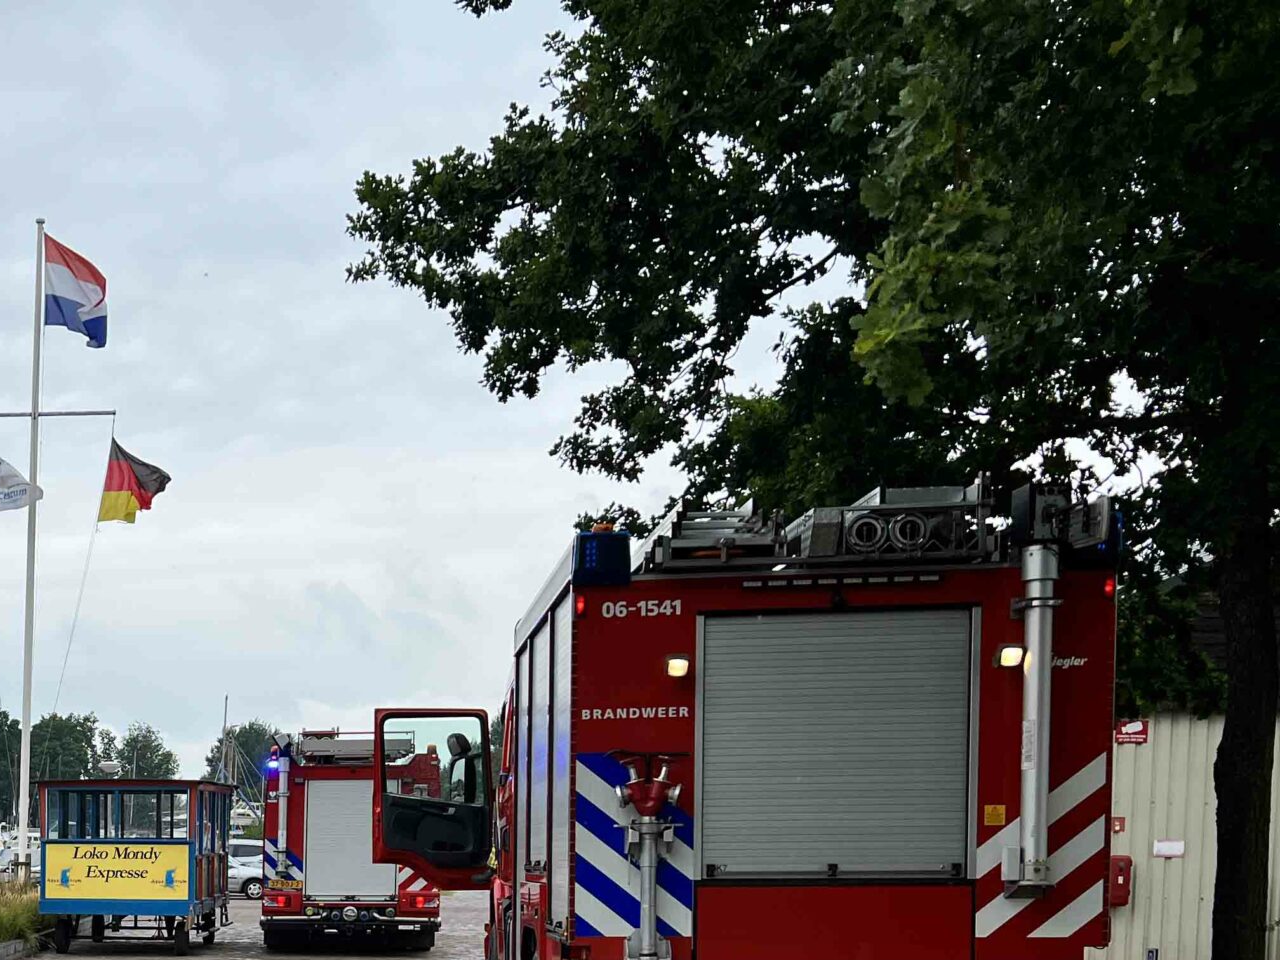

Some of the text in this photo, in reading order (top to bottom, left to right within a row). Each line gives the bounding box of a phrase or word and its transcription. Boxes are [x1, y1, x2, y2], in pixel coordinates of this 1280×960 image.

[601, 599, 682, 618] 06-1541
[1051, 655, 1089, 669] iegler
[581, 706, 689, 720] BRANDWEER
[72, 846, 162, 864] Loko Mondy
[85, 865, 148, 883] Expresse
